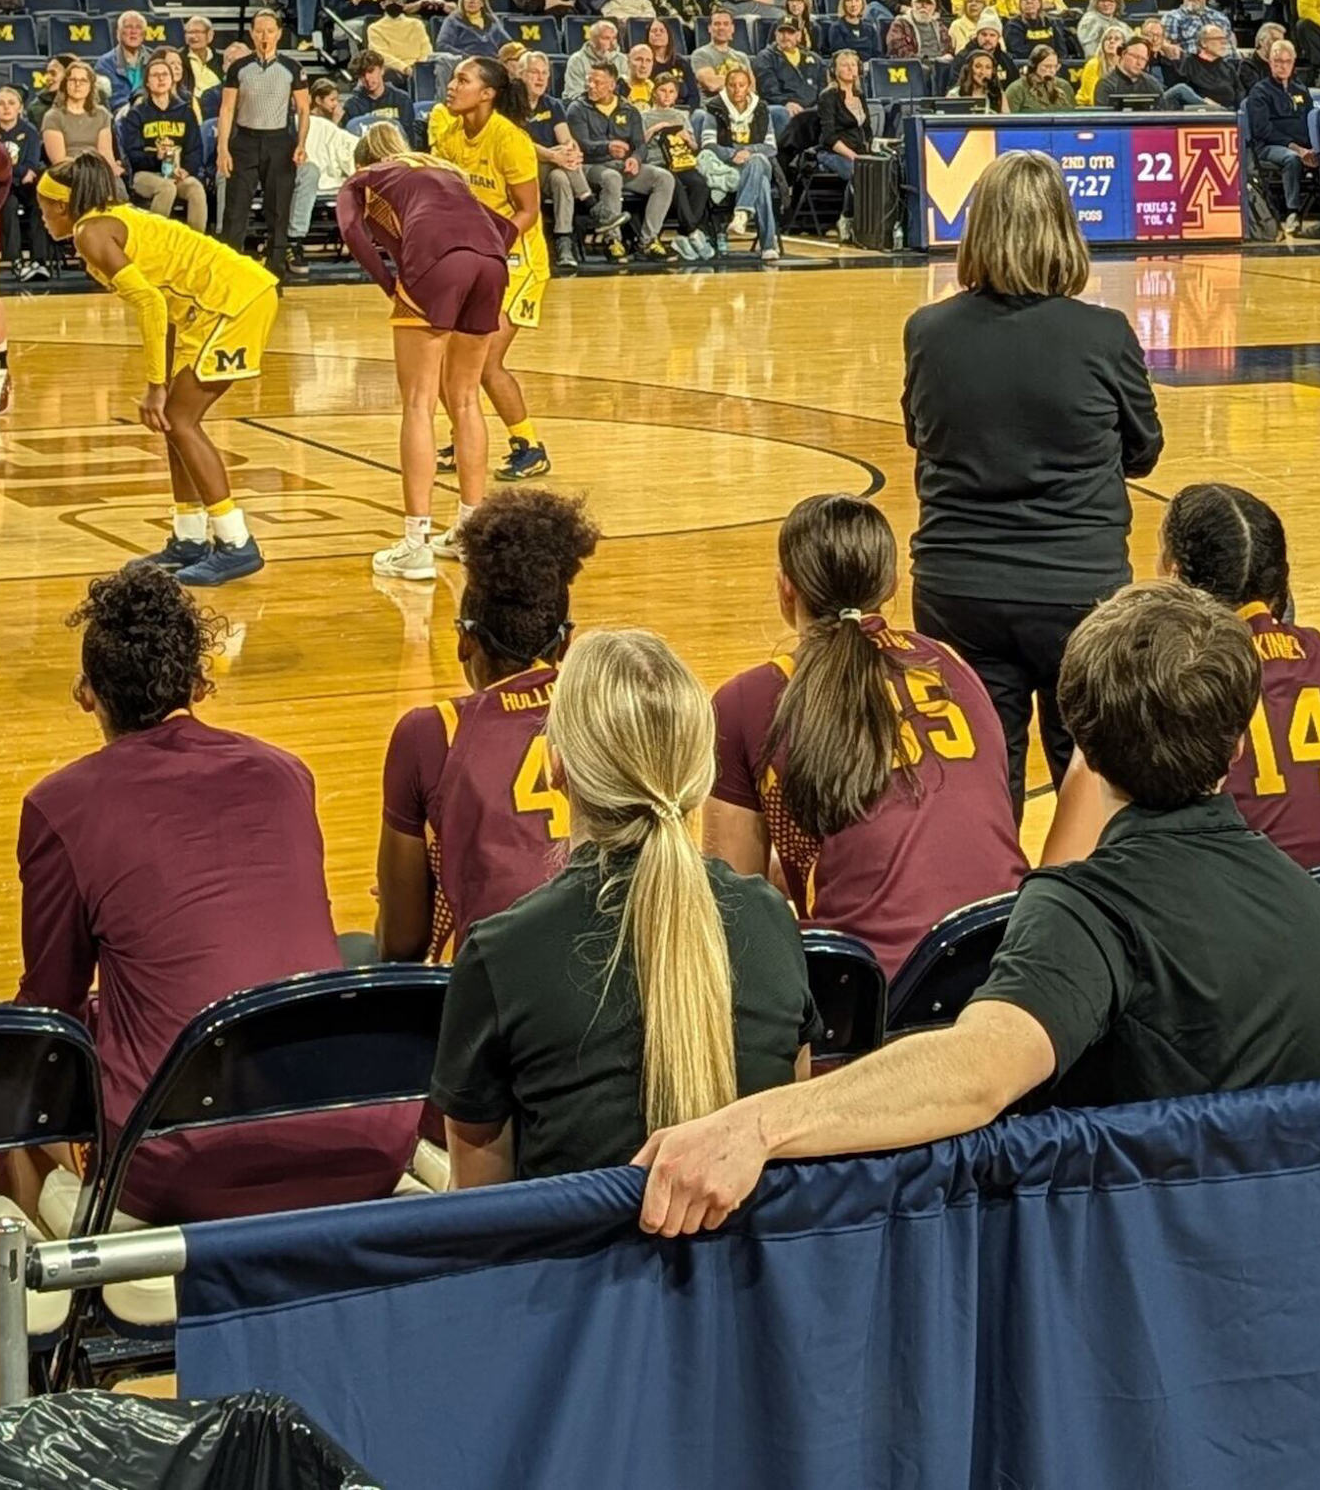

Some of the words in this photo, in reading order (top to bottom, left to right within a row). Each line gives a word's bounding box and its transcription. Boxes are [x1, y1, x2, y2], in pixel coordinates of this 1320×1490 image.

[69, 25, 93, 43] M
[889, 68, 910, 85] M
[1061, 155, 1085, 170] 2ND
[1089, 155, 1115, 170] QTR
[1136, 152, 1174, 181] 22
[1065, 174, 1111, 197] 7:27
[521, 299, 536, 319] M
[214, 347, 246, 371] M
[512, 733, 571, 840] 4
